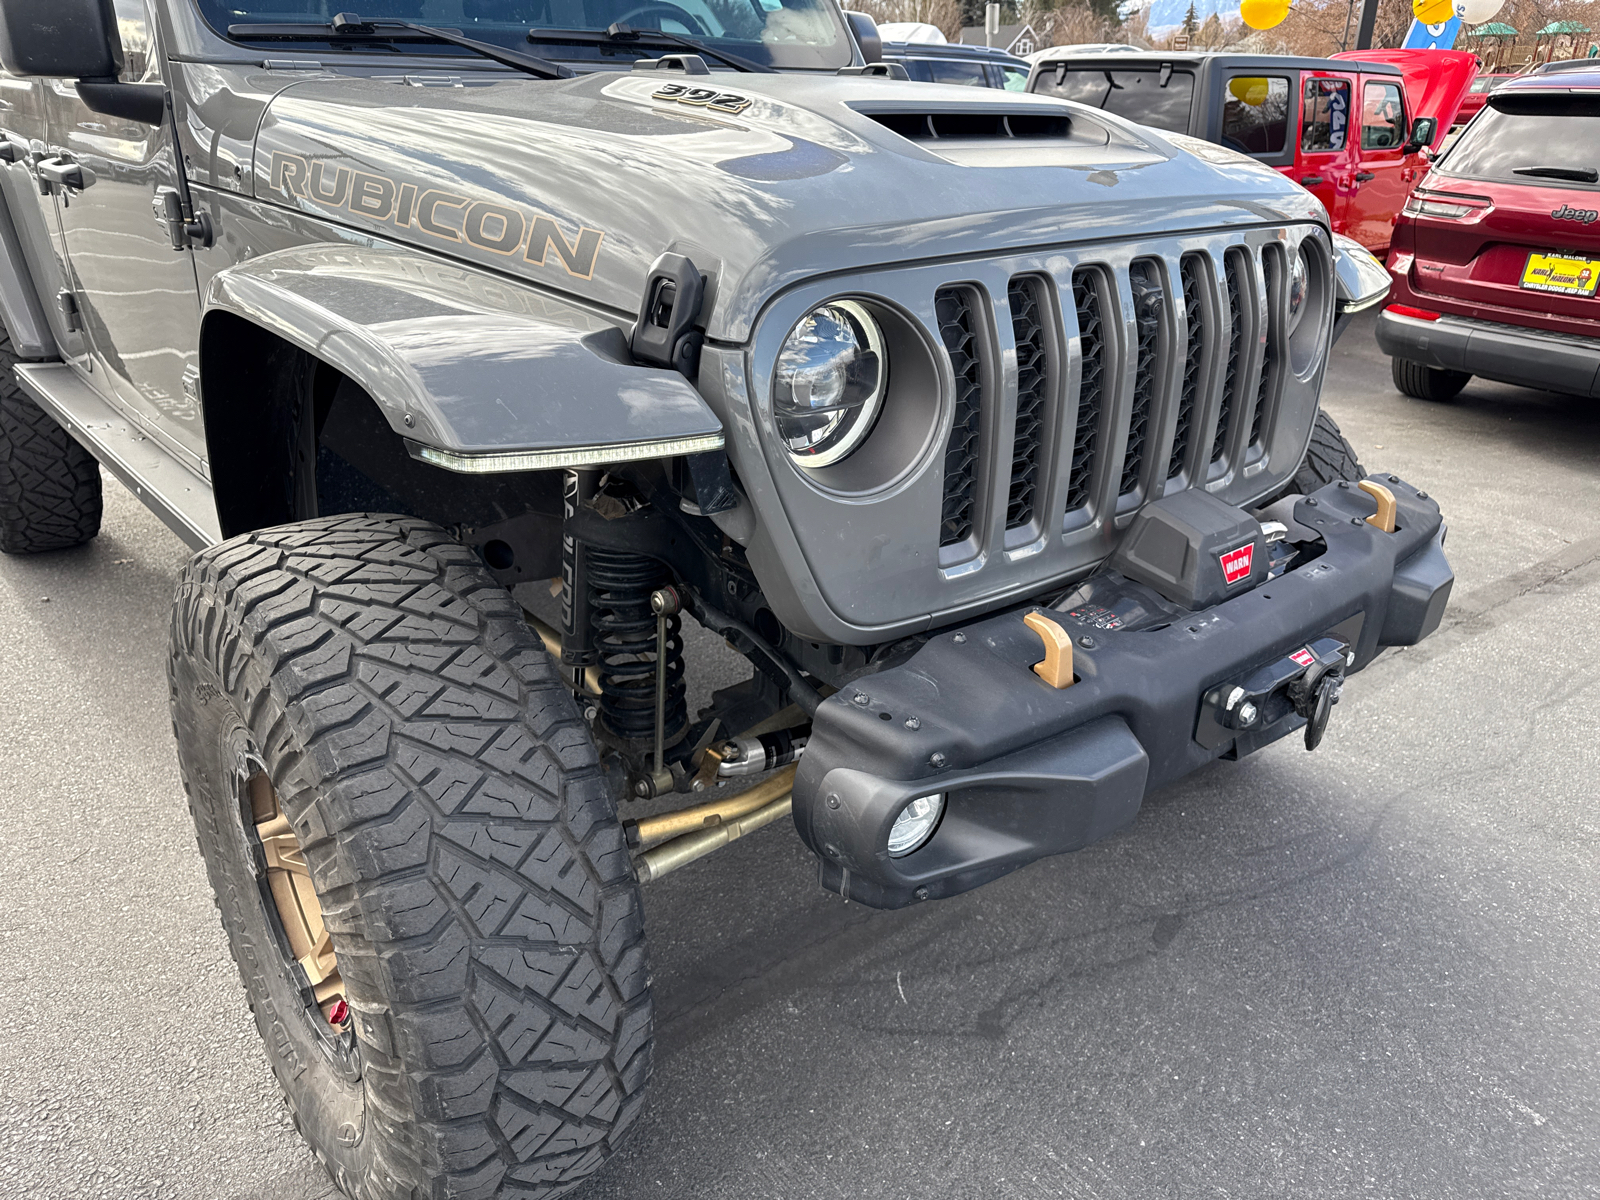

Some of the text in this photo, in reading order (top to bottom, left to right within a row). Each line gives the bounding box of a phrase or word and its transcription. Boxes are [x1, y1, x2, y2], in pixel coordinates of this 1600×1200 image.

[652, 83, 753, 115] 392
[269, 149, 605, 281] RUBICON
[1551, 204, 1598, 224] Jeep
[1226, 555, 1249, 574] WARN
